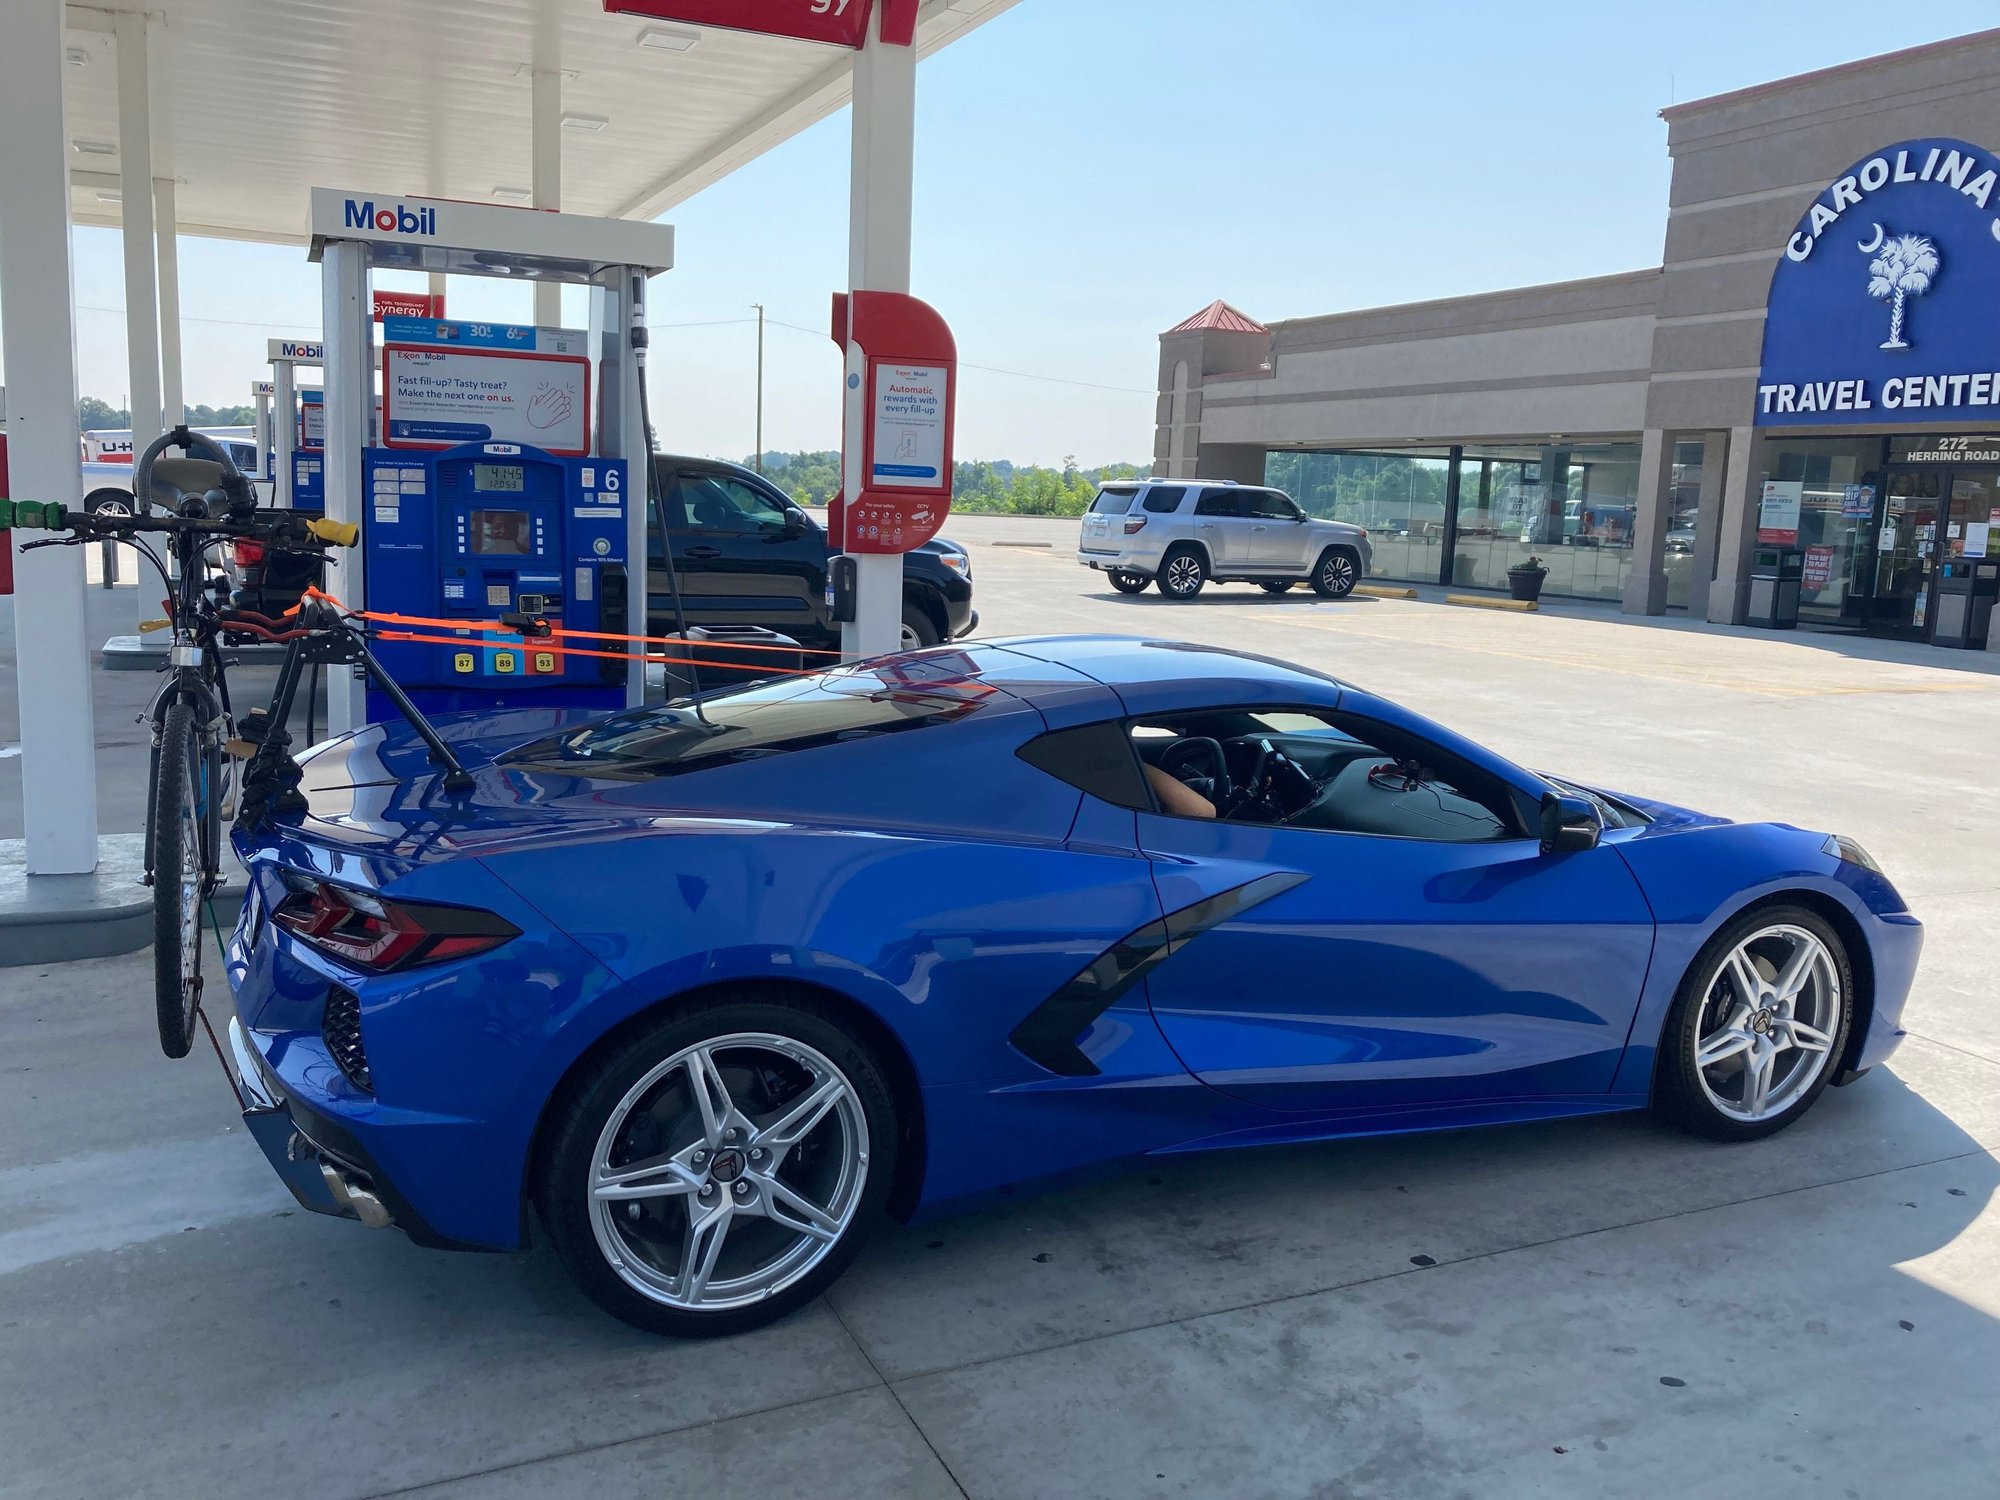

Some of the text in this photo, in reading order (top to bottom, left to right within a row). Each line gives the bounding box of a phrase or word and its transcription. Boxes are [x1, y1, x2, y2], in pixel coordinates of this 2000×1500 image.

[1786, 148, 2000, 262] CAROLINA
[345, 199, 435, 235] Mobil
[374, 302, 424, 317] Synergy
[282, 343, 323, 358] Mobil
[397, 351, 420, 360] Exxon
[398, 376, 507, 390] Fast fill-up? Tasty treat?
[889, 384, 933, 395] Automatic
[398, 388, 425, 398] Make
[427, 390, 442, 399] the
[444, 391, 465, 400] next
[883, 395, 938, 405] rewards with
[1760, 379, 1870, 413] TRAVEL
[885, 404, 935, 416] every fill-up
[493, 445, 512, 453] Mobil
[1939, 437, 1968, 450] 272
[1907, 450, 1999, 461] HERRING ROAD
[605, 469, 620, 491] 6
